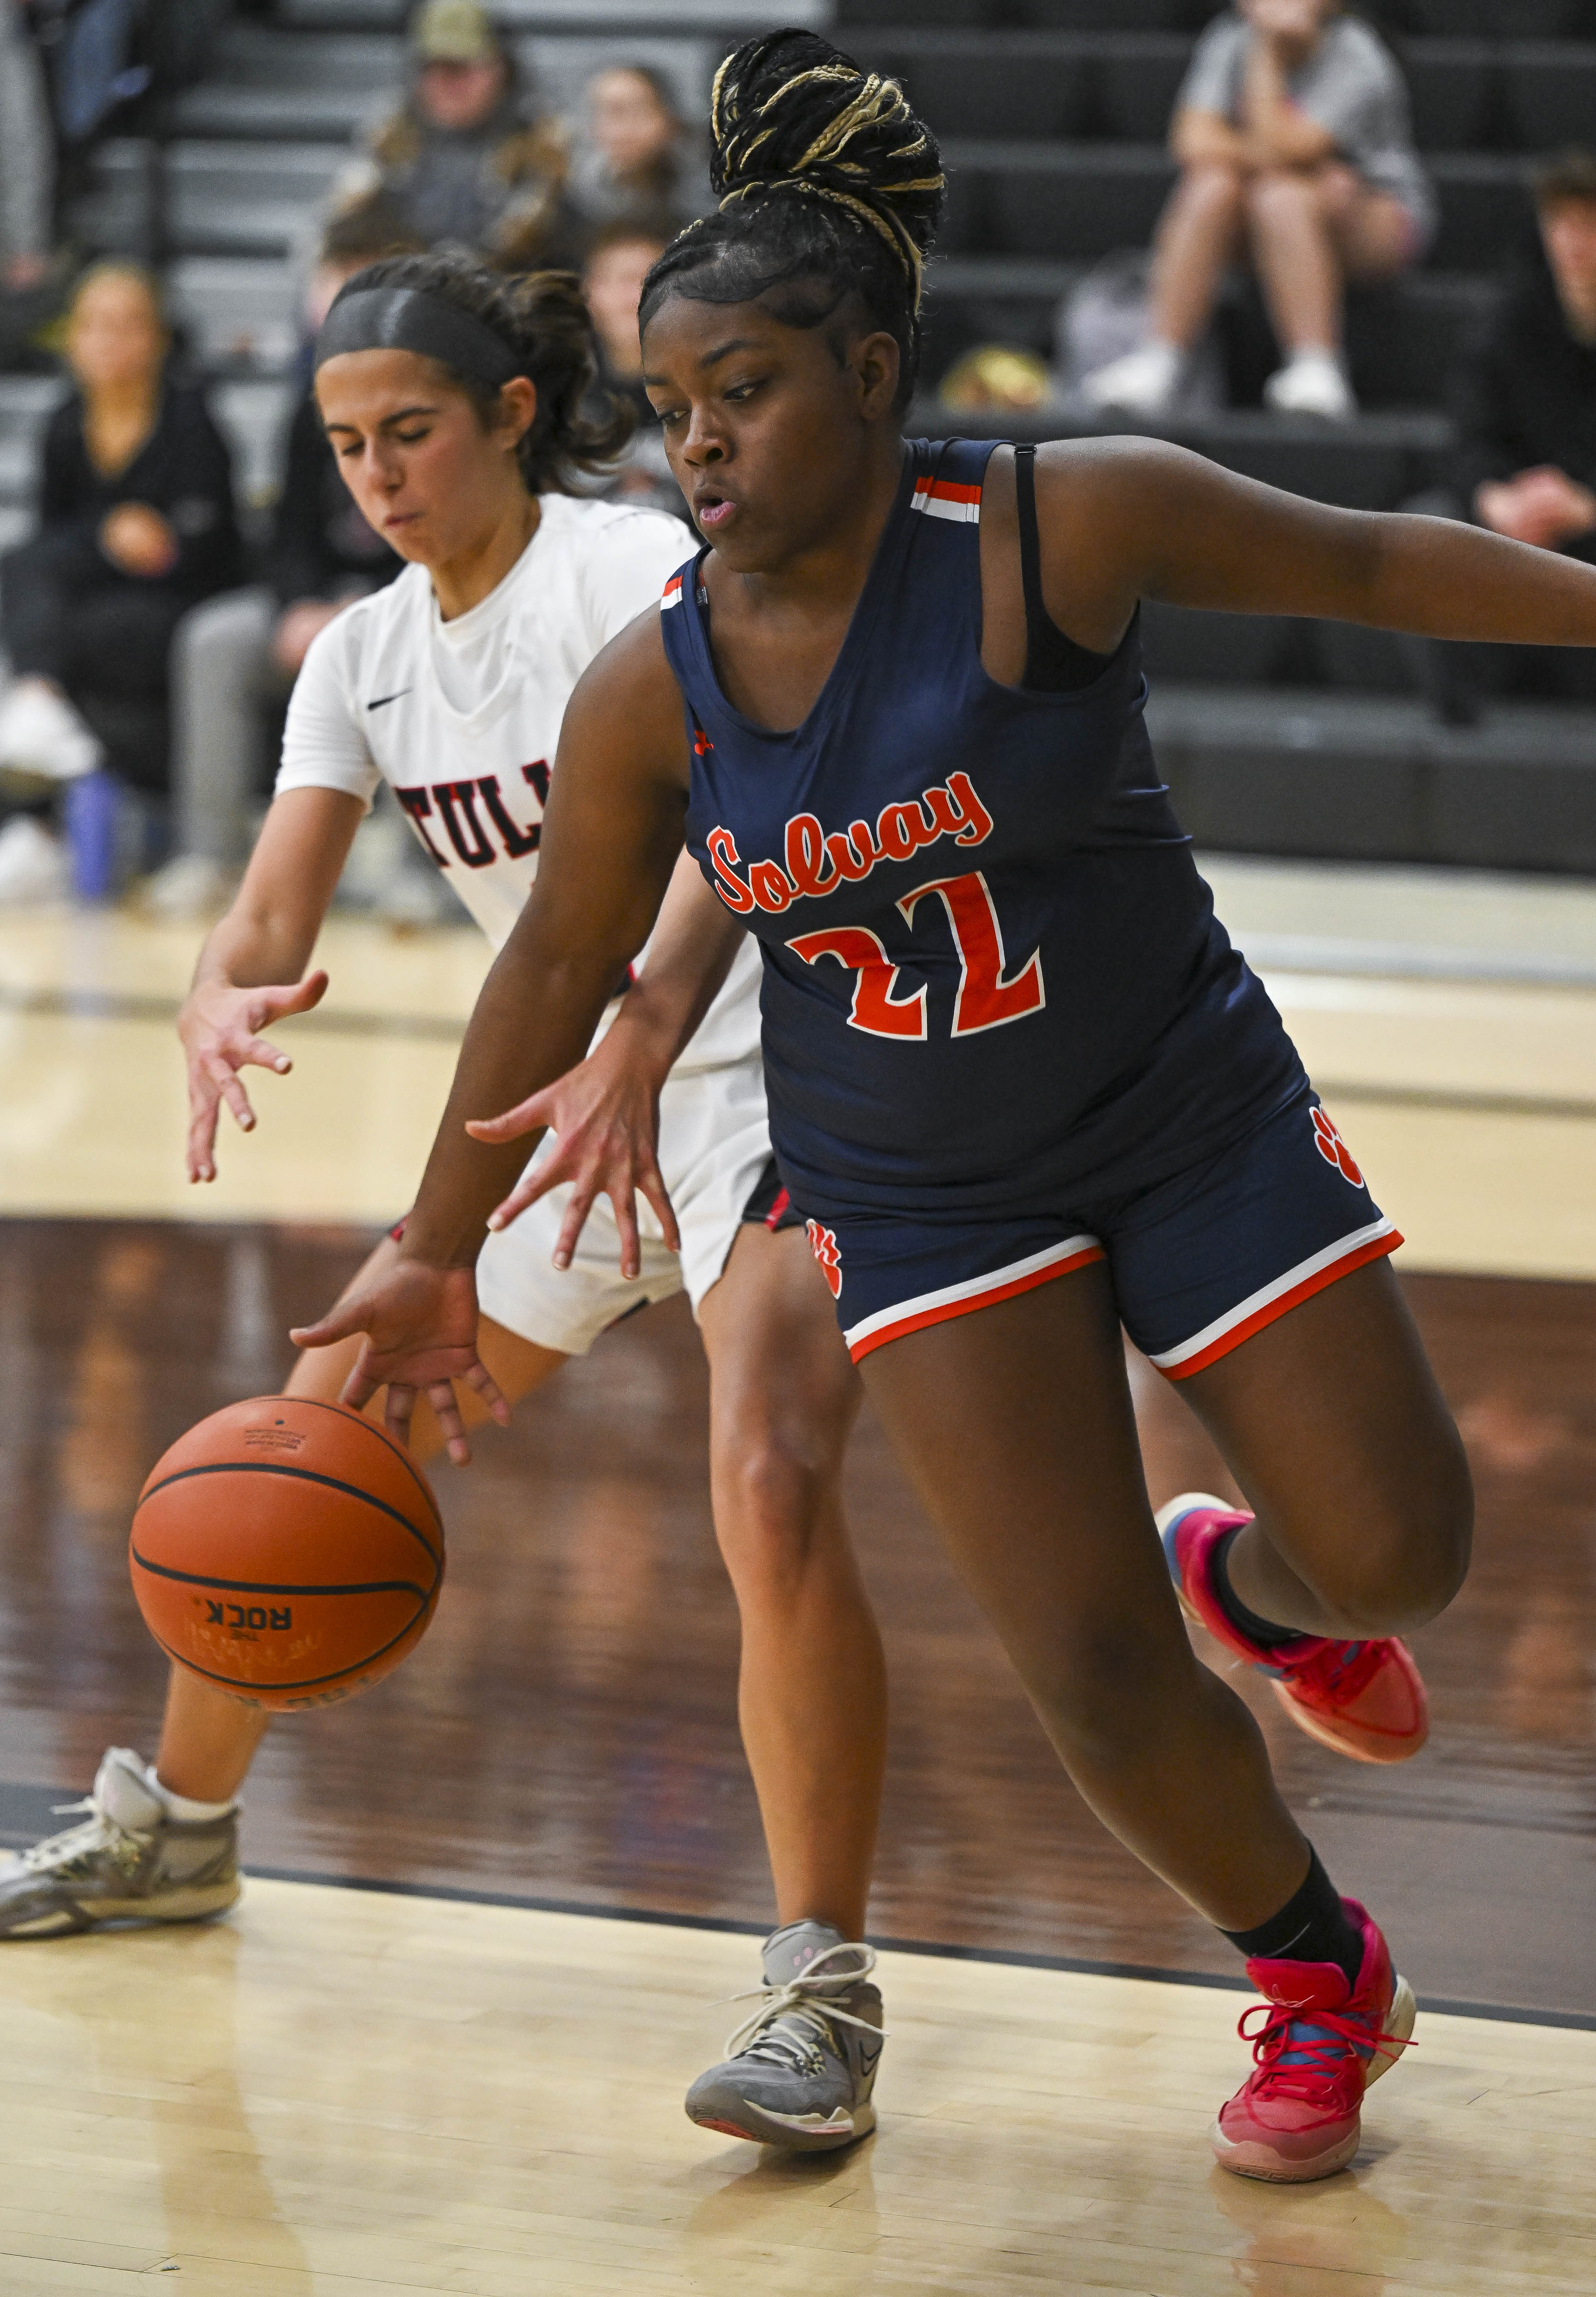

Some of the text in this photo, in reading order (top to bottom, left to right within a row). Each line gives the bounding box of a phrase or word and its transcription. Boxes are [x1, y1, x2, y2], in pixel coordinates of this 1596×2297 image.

[706, 771, 994, 914] Solvay
[784, 870, 1046, 1041] 22
[205, 1599, 291, 1630] ROCK
